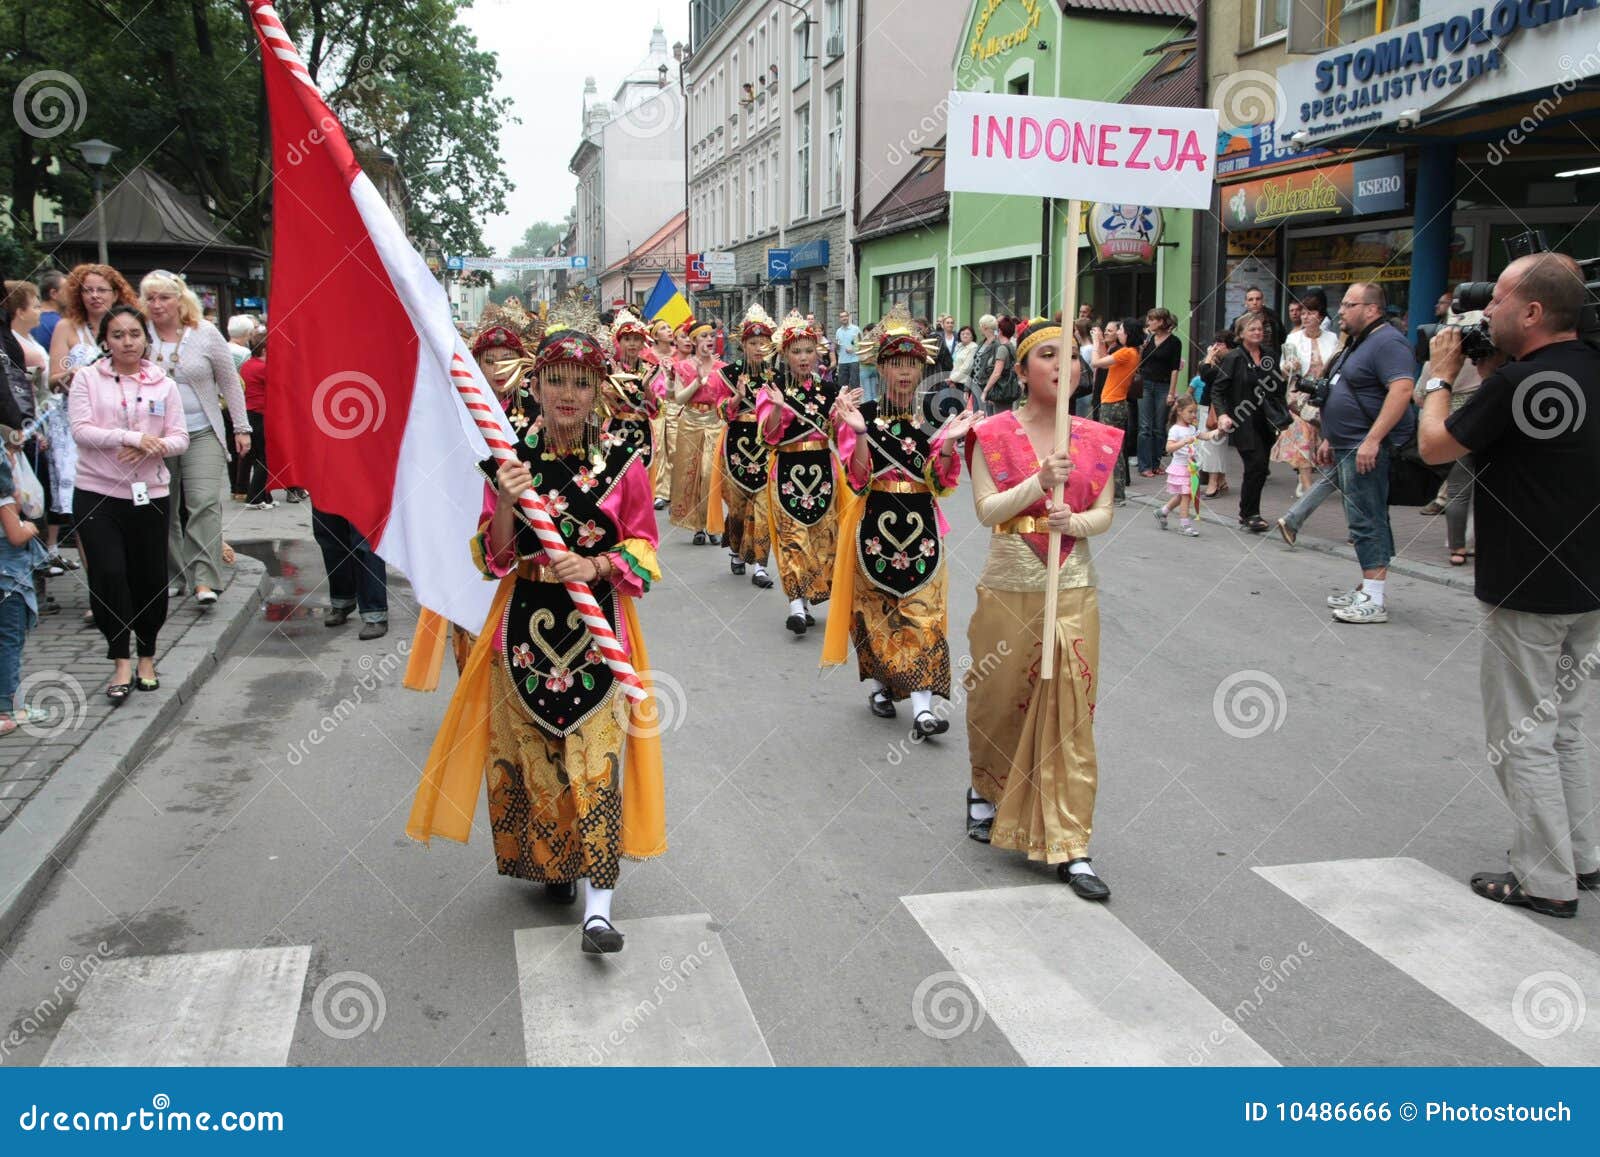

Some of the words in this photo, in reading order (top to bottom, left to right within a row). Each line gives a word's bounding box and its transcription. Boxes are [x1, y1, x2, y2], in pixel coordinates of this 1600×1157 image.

[971, 115, 1207, 172] INDONEZJA
[1357, 175, 1400, 197] KSERO
[1290, 273, 1316, 283] KSERO
[1318, 271, 1347, 282] KSERO
